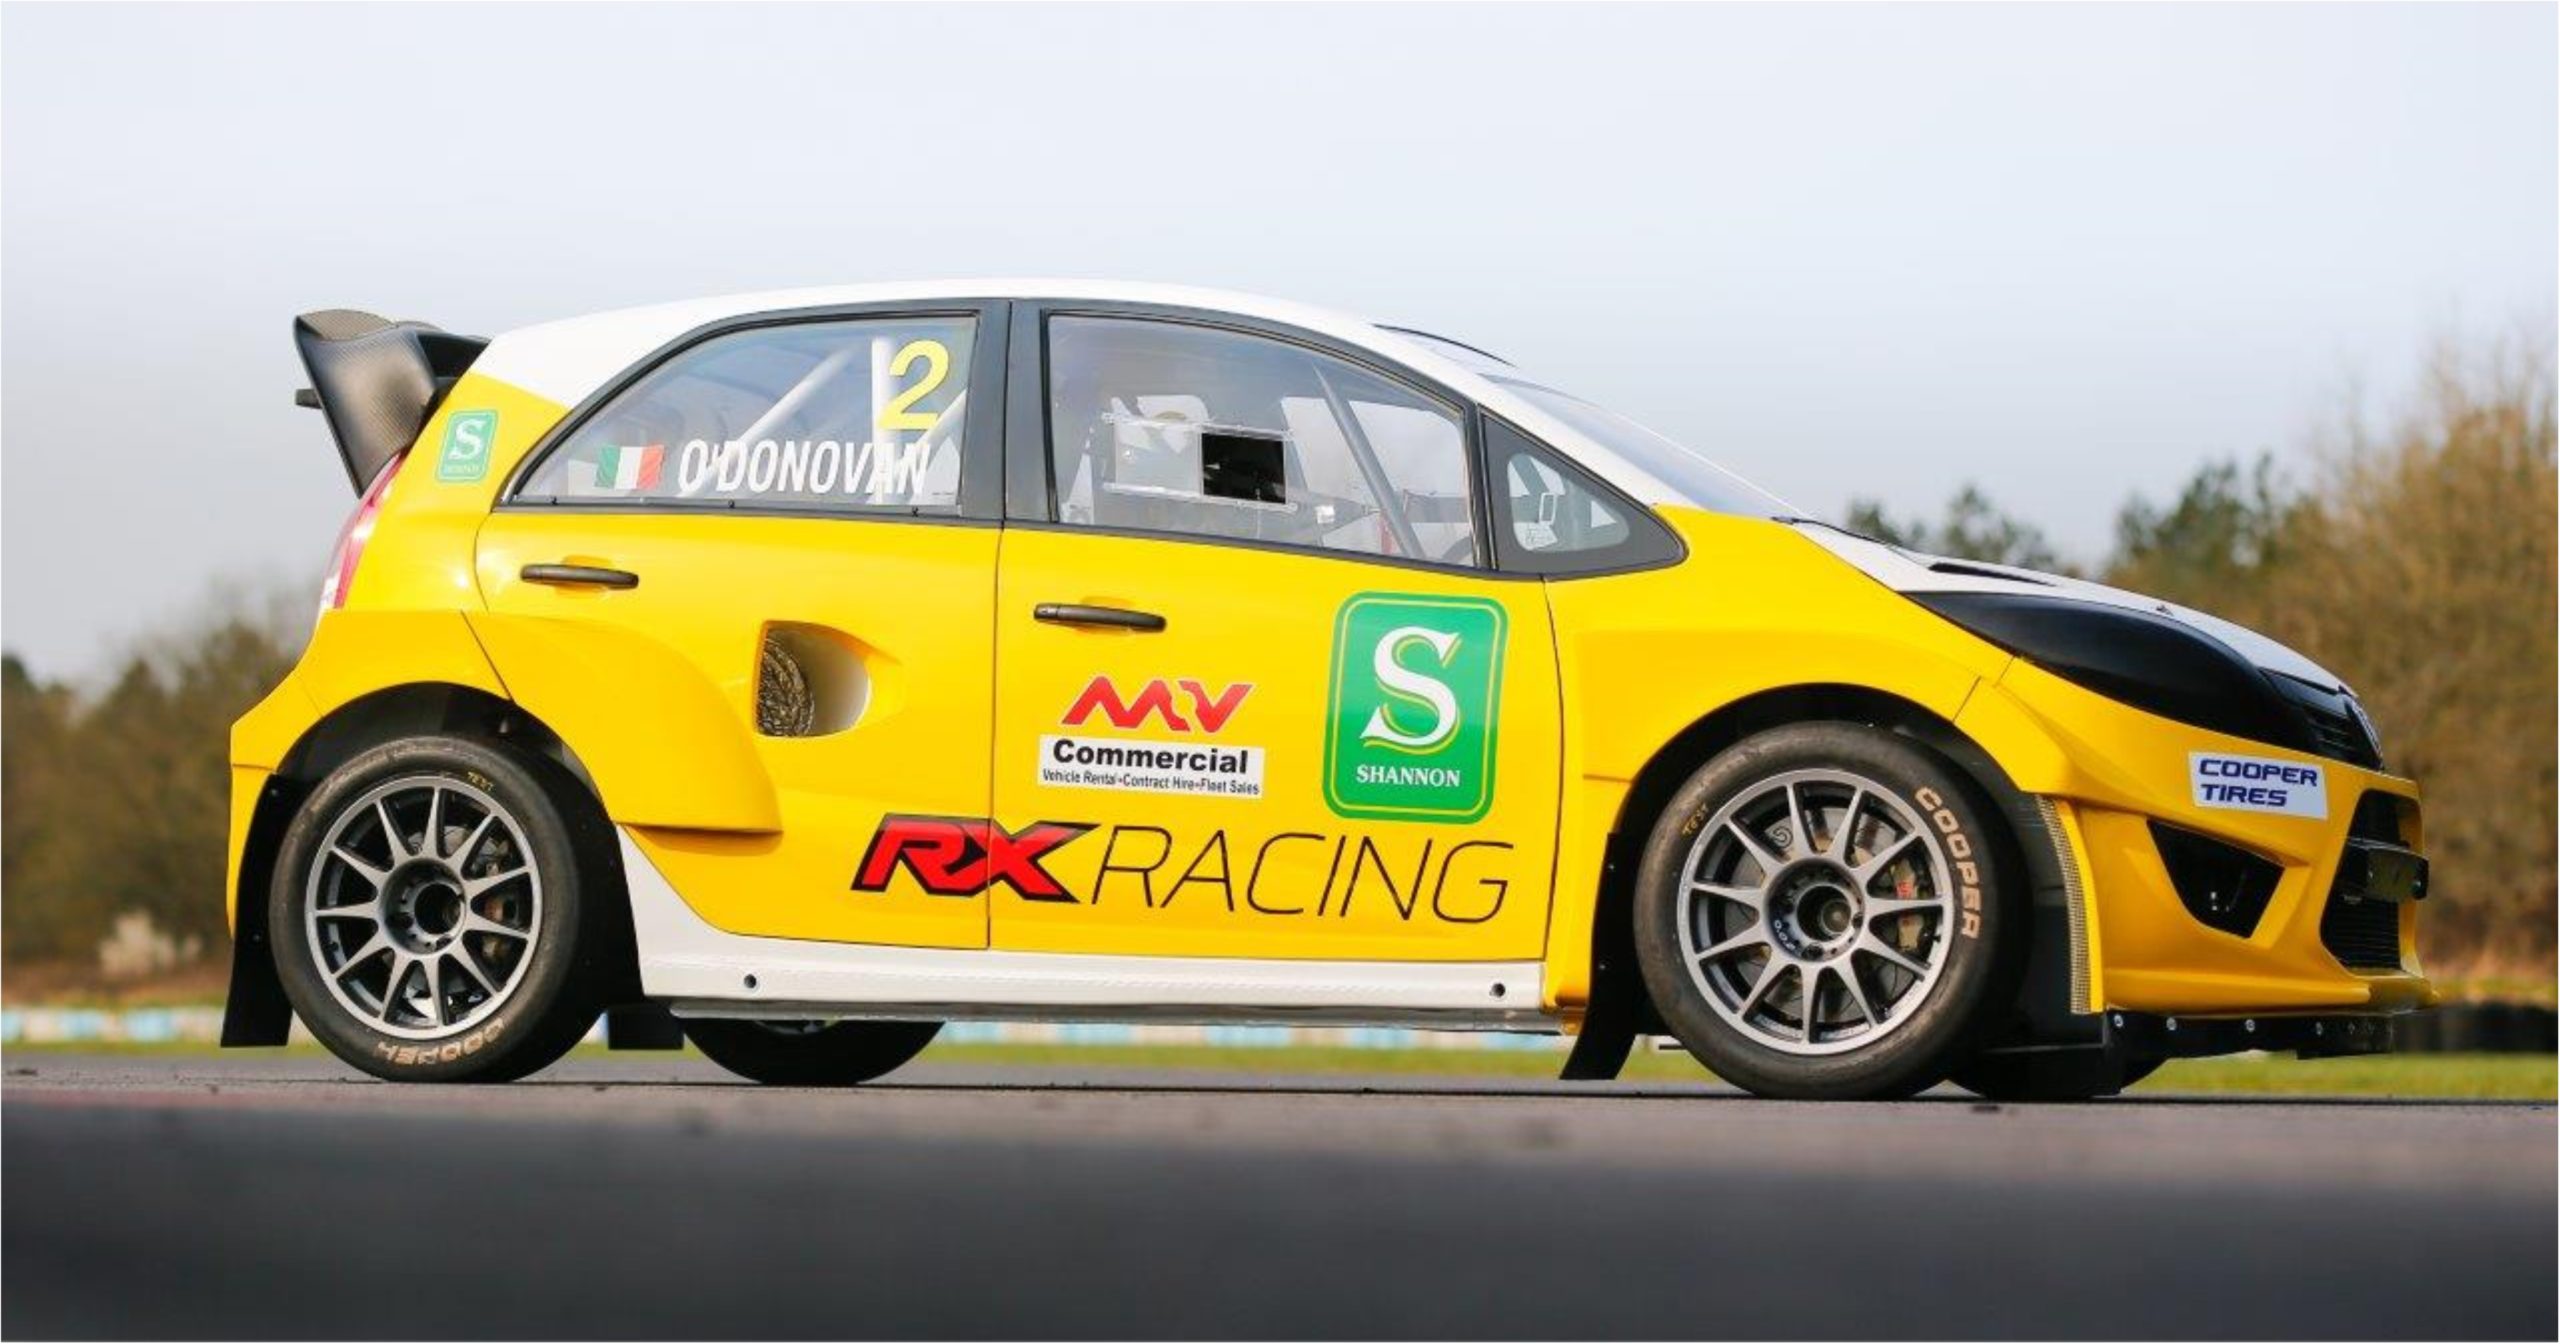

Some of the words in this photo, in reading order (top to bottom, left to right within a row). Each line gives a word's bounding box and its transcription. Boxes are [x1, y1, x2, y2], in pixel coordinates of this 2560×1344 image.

[878, 339, 950, 431] 2
[447, 419, 486, 460] S
[677, 438, 931, 494] O'DONOVAN
[1061, 675, 1253, 733] MV
[1360, 625, 1463, 755] S
[1053, 738, 1248, 774] Commercial
[1356, 763, 1461, 787] SHANNON
[2199, 758, 2318, 787] COOPER
[1042, 768, 1080, 784] Vehicle
[1229, 780, 1260, 795] Sales
[2200, 783, 2287, 808] TIRES
[851, 813, 1101, 904] RX
[1091, 824, 1514, 924] RACING
[1914, 786, 1983, 940] COOPER
[376, 1017, 505, 1066] COOPER
